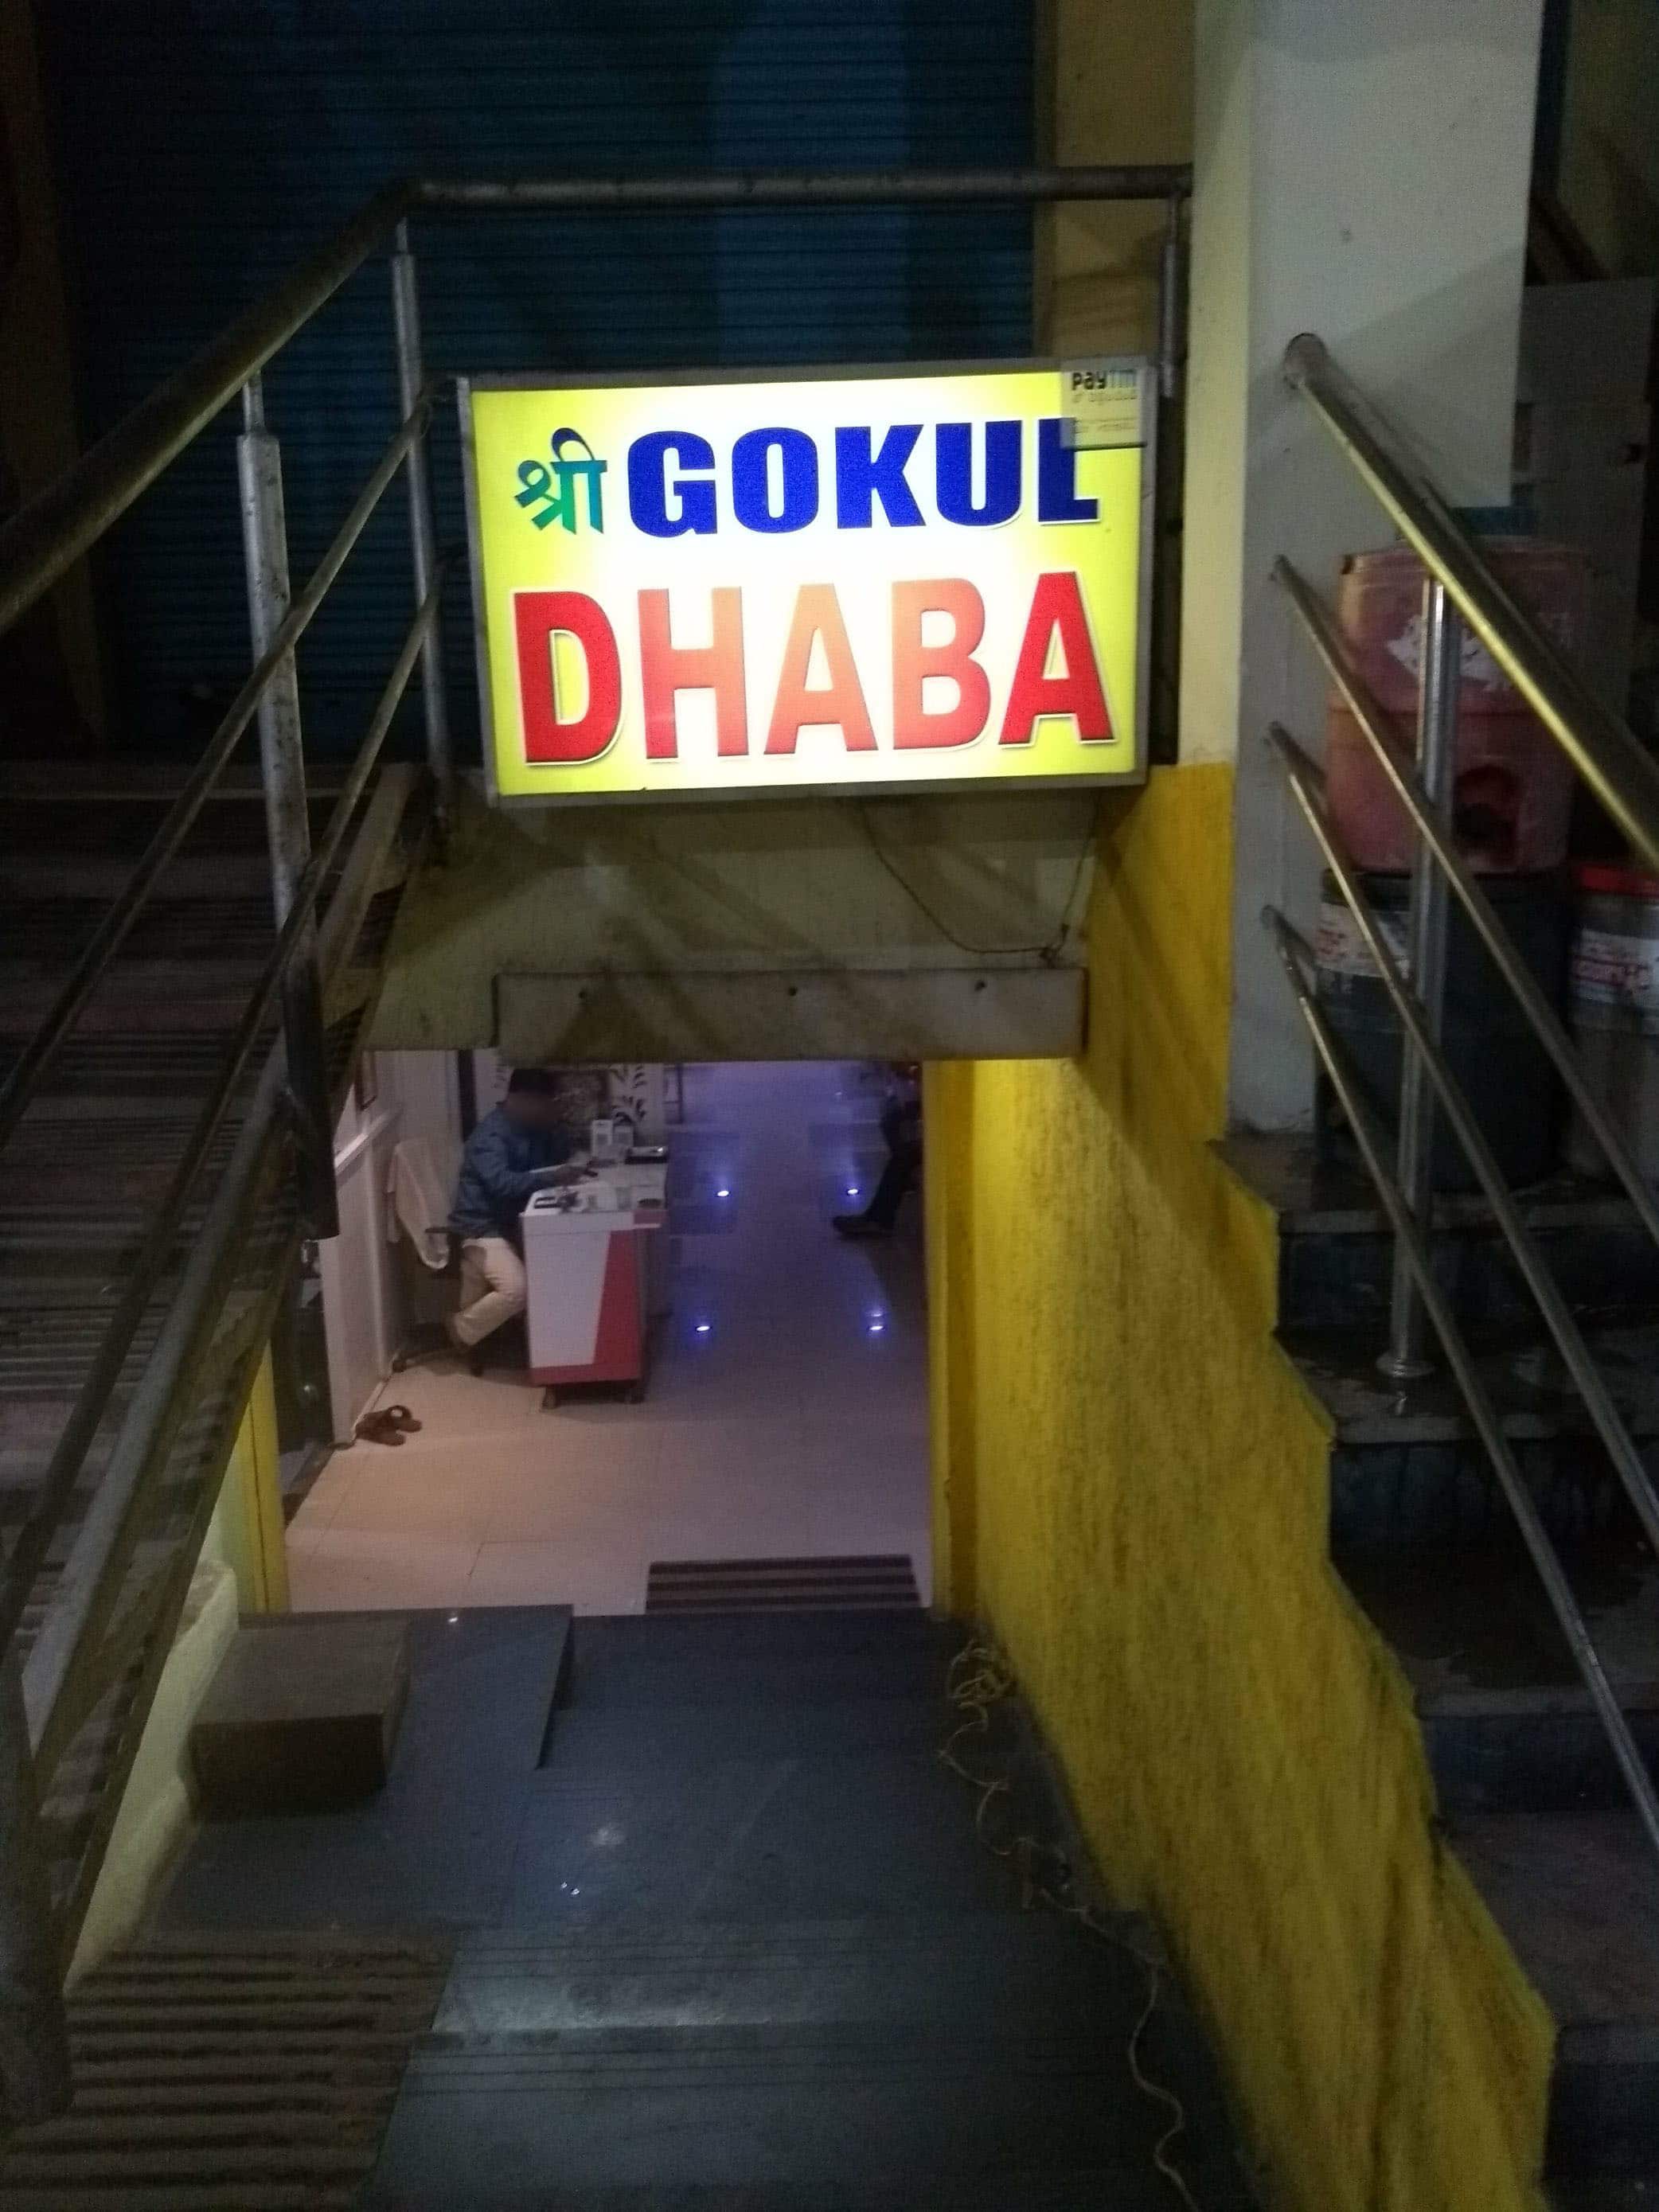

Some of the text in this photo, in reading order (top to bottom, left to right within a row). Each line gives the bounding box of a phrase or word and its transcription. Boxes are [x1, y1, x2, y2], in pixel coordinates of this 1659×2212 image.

[513, 418, 1099, 537] श्री GOKUL
[513, 571, 1115, 763] DHABA
